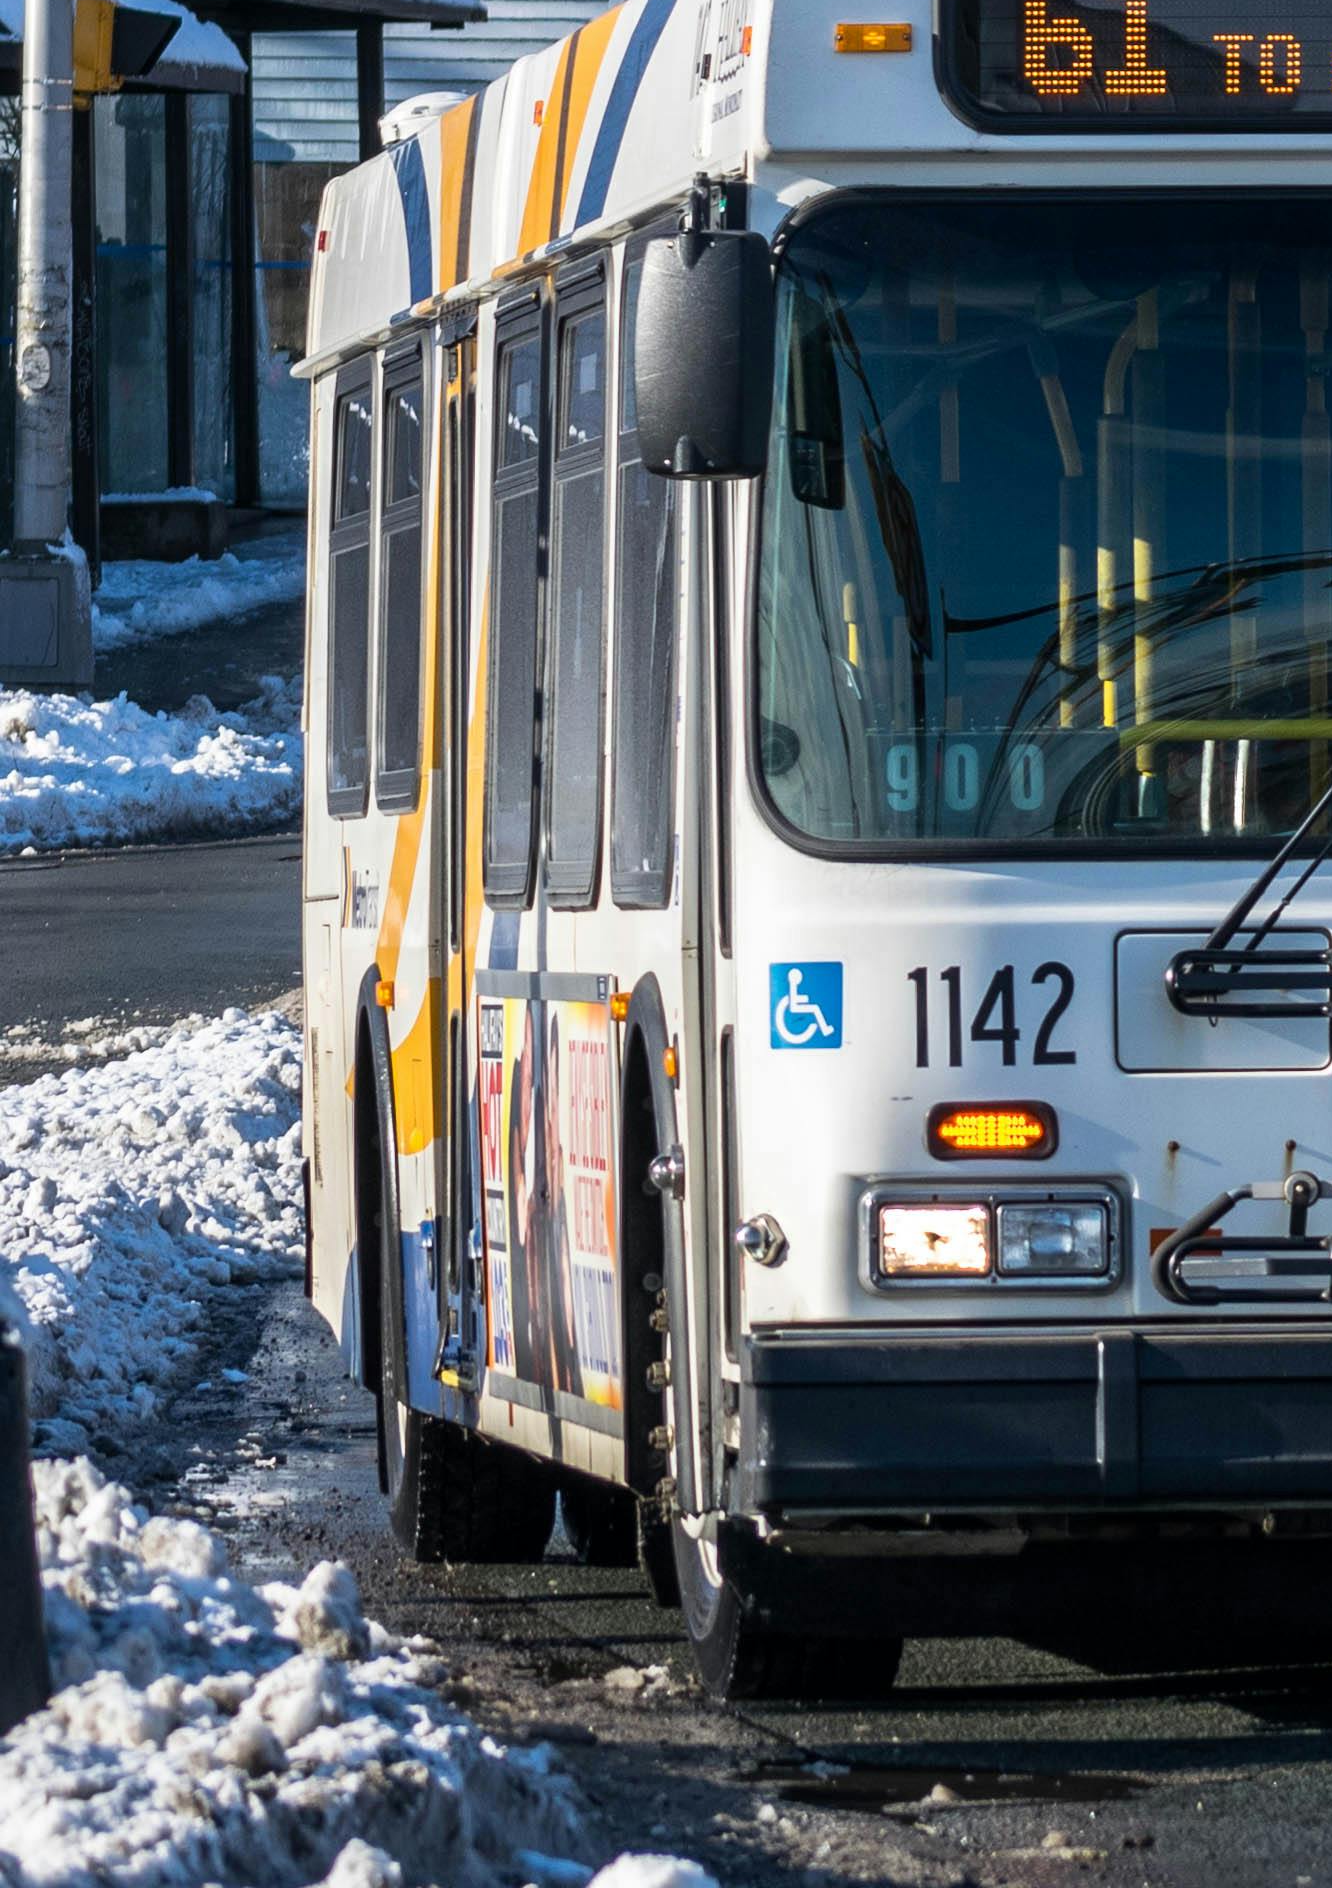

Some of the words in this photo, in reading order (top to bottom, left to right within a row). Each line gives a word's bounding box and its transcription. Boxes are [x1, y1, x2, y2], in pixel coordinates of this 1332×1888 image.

[1213, 33, 1301, 94] TO
[885, 742, 1045, 812] 900
[906, 960, 1077, 1068] 1142
